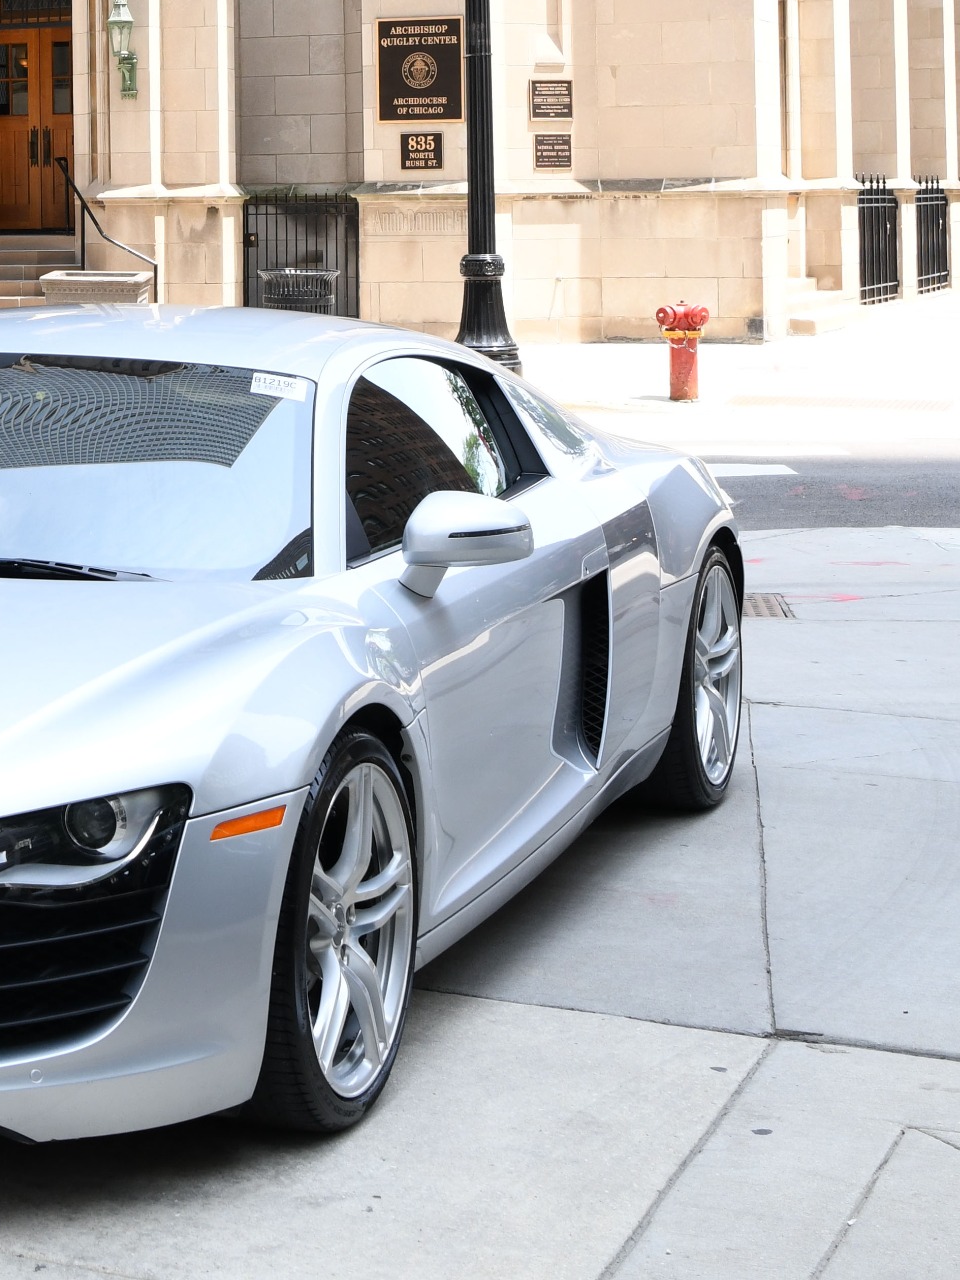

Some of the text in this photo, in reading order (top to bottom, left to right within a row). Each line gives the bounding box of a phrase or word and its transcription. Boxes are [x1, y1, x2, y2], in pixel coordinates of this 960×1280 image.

[390, 25, 448, 35] ARCHBISHOP
[381, 36, 458, 47] QUIGLEY CENTER
[393, 97, 448, 105] ARCHDIOCESE
[409, 106, 444, 114] CHICAGO
[408, 136, 435, 150] 835
[254, 376, 297, 389] B1219C
